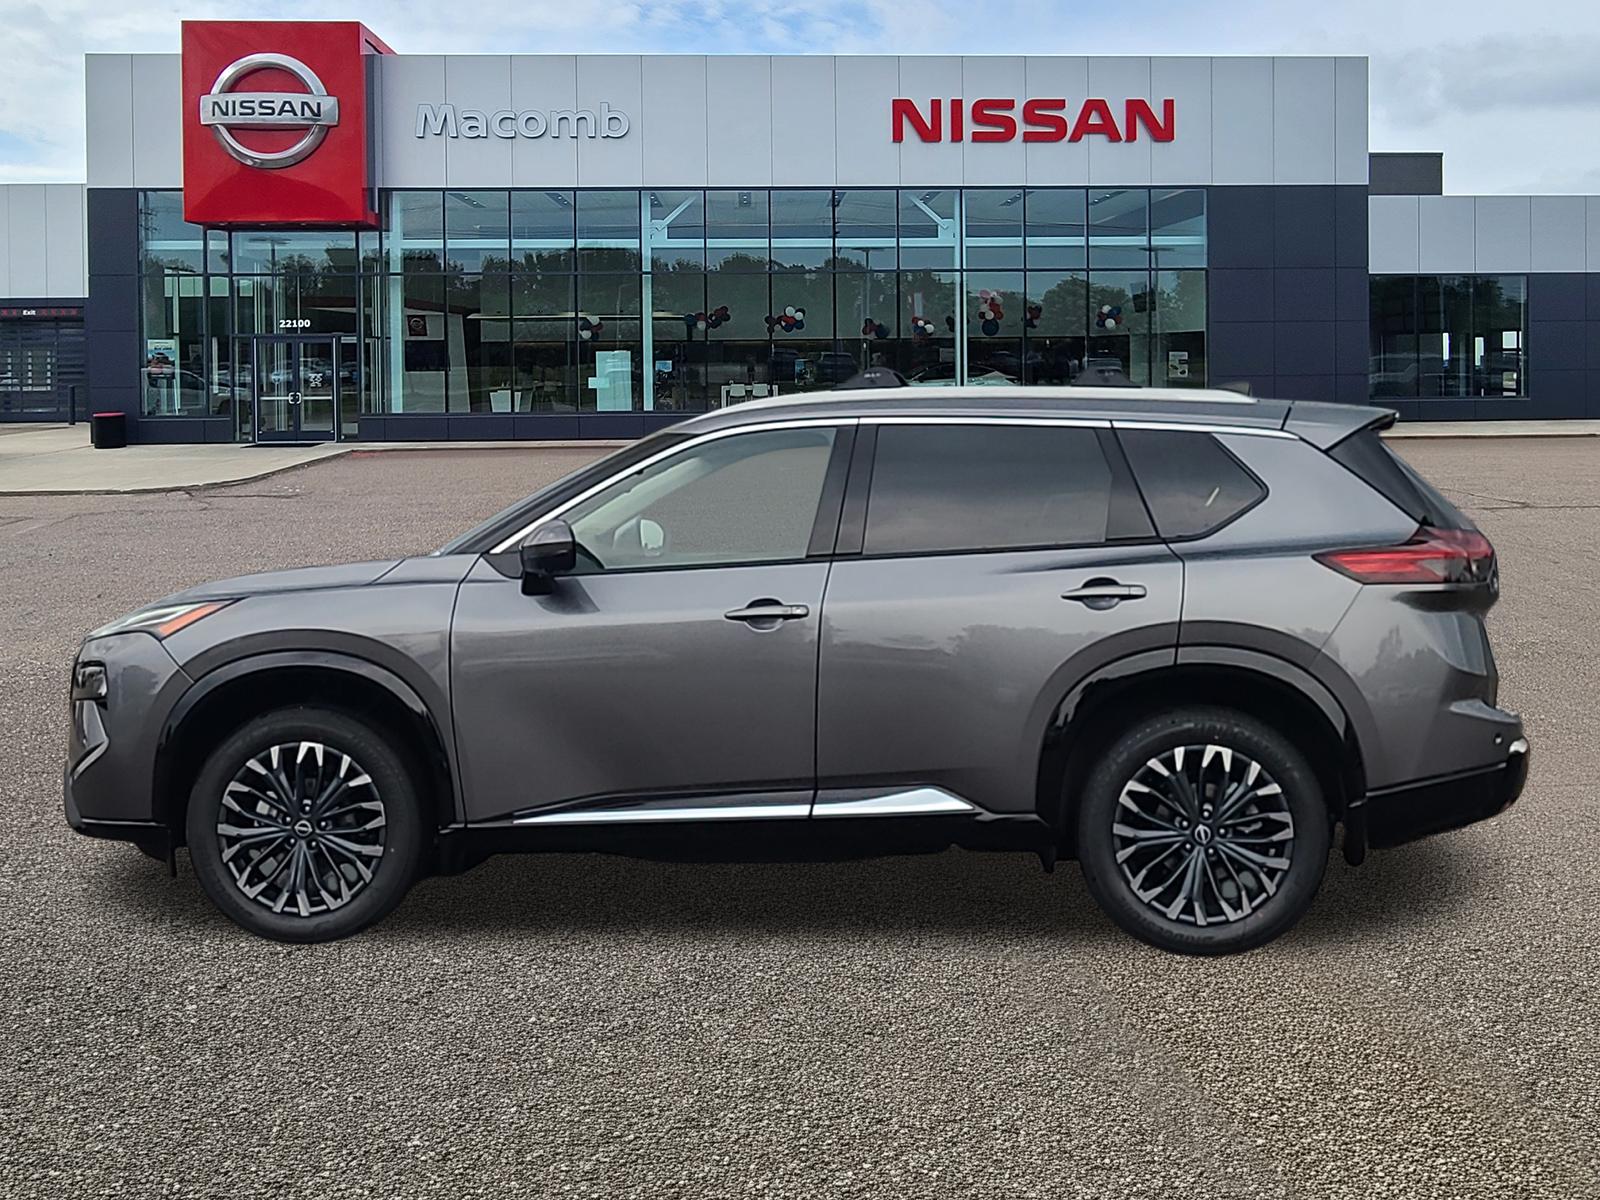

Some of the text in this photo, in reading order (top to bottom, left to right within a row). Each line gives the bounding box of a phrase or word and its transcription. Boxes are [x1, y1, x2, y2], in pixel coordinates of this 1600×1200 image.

[211, 99, 323, 119] NISSAN
[415, 101, 631, 139] Macomb
[891, 98, 1176, 143] NISSAN
[279, 319, 311, 328] 22100
